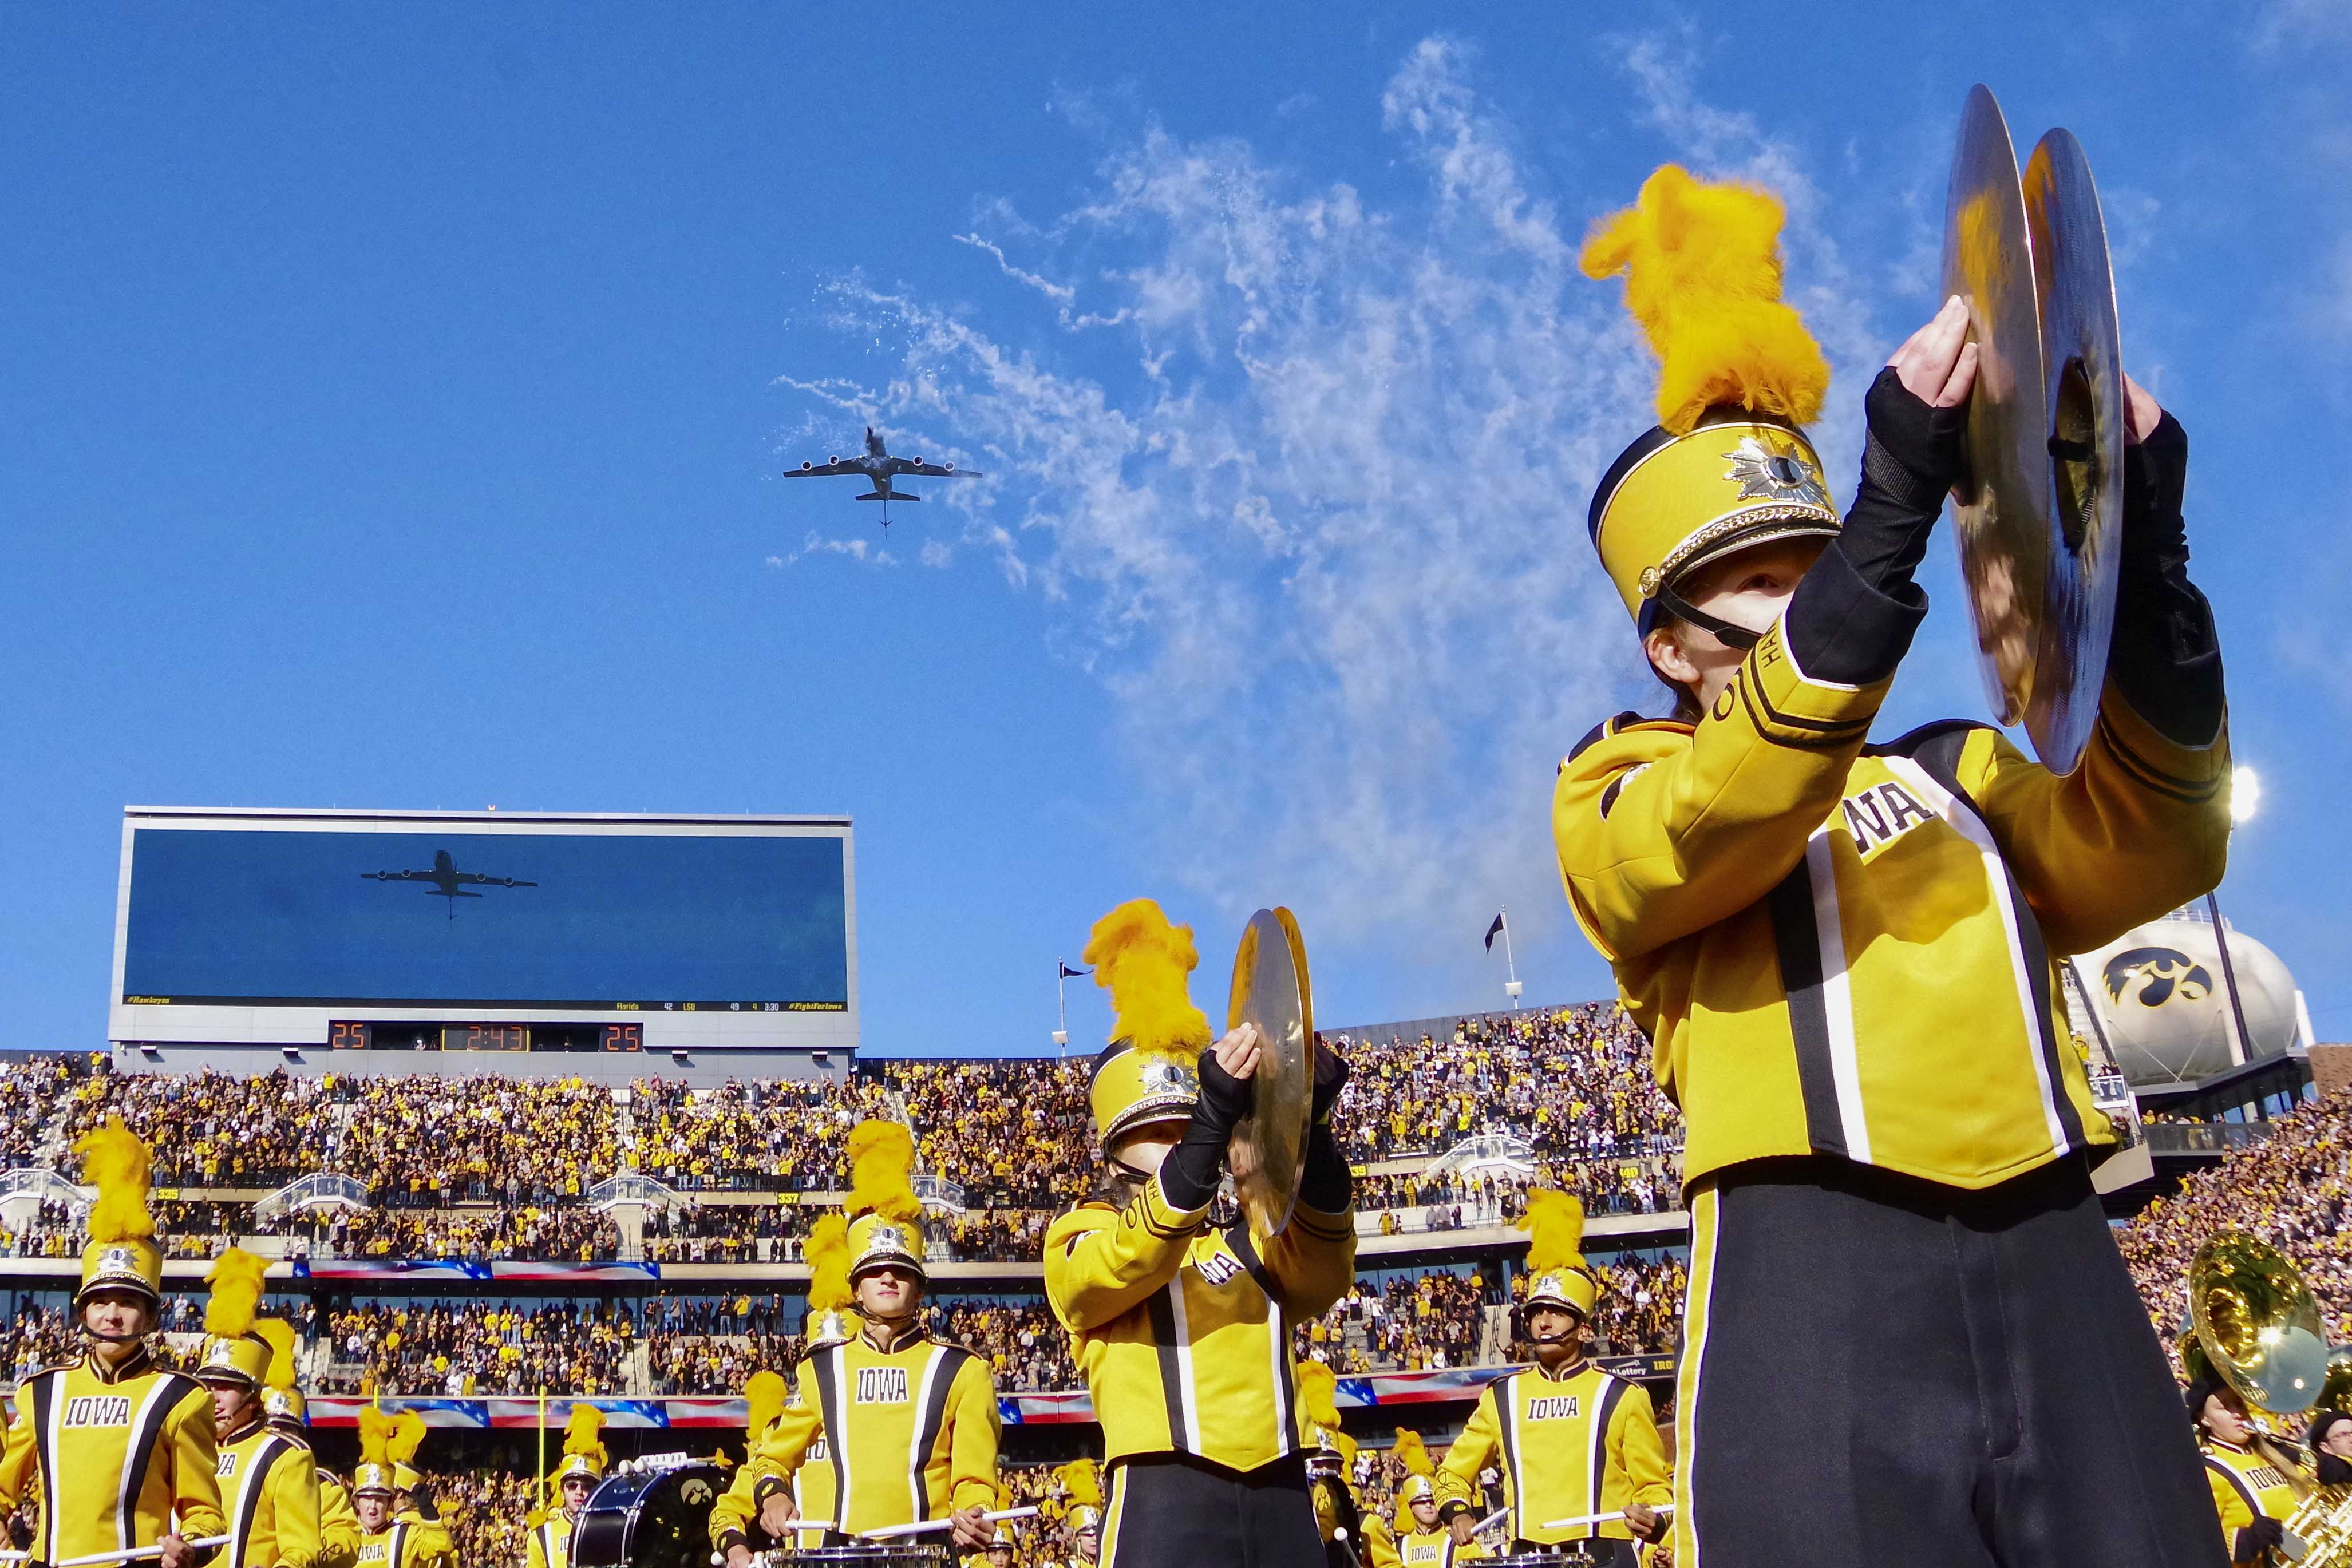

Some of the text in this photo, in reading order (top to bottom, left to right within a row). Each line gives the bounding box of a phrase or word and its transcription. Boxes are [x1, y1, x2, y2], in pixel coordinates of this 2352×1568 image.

[127, 996, 170, 1005] #Hawkeyes
[616, 1002, 639, 1011] Florida
[664, 1002, 673, 1011] 42
[683, 1002, 695, 1011] LSU
[730, 1002, 740, 1011] 49
[764, 1003, 779, 1011] 3:30
[788, 1002, 843, 1011] #FightForIowa
[332, 1024, 365, 1048] 25
[467, 1025, 522, 1050] 2:43
[607, 1026, 639, 1051] 25
[1350, 1166, 1366, 1177] 39
[778, 1193, 799, 1204] 337
[857, 1368, 907, 1401] IOWA
[65, 1397, 129, 1426] IOWA
[1528, 1396, 1578, 1419] IOWA
[1411, 1546, 1436, 1561] IOWA
